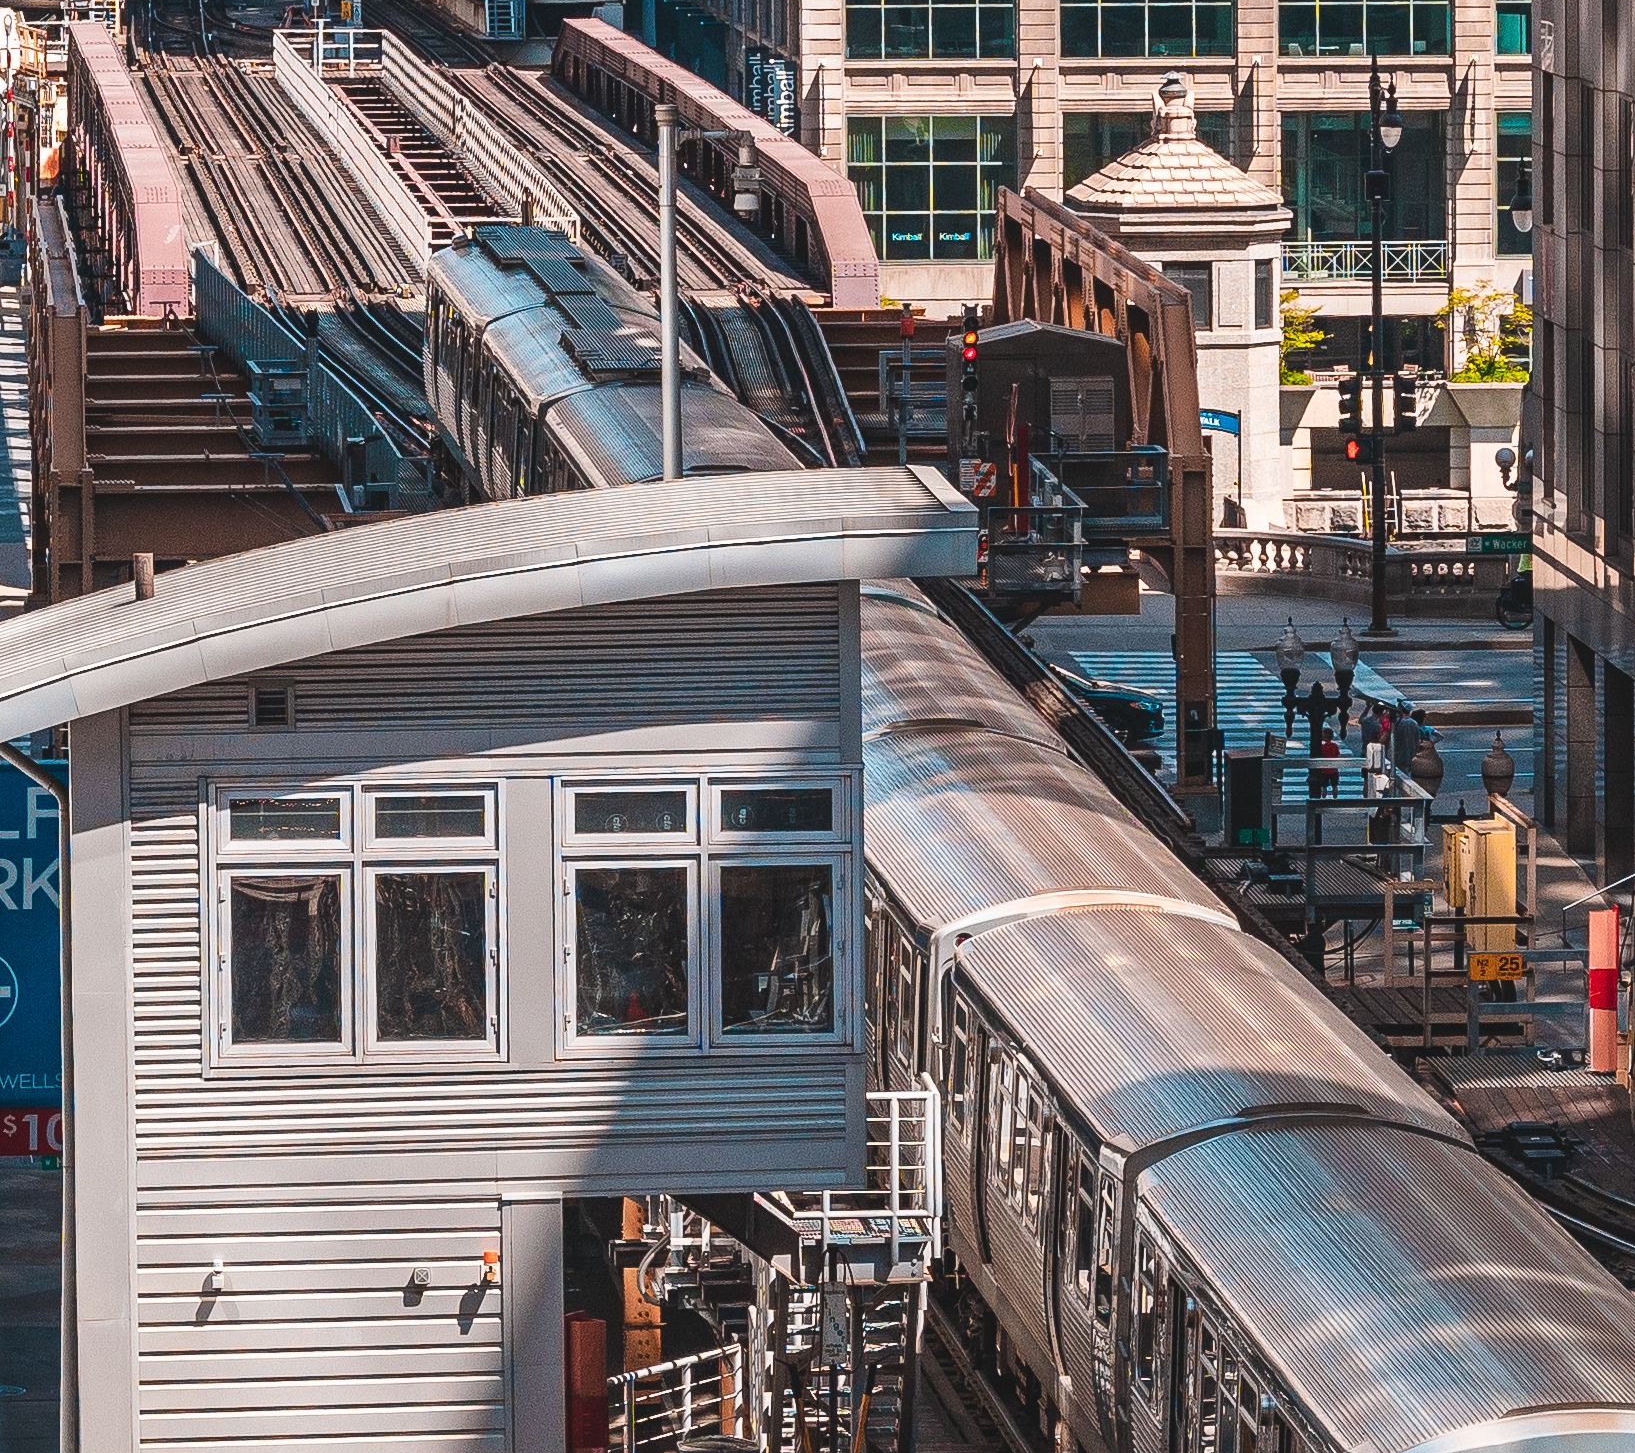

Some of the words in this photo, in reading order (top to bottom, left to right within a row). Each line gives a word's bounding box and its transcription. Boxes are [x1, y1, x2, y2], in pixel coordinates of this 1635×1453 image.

[749, 53, 761, 111] imball
[764, 64, 776, 120] imball
[892, 232, 923, 241] Kimball
[939, 232, 971, 241] Kimball
[1493, 539, 1528, 549] Wacker
[1498, 956, 1520, 971] 25
